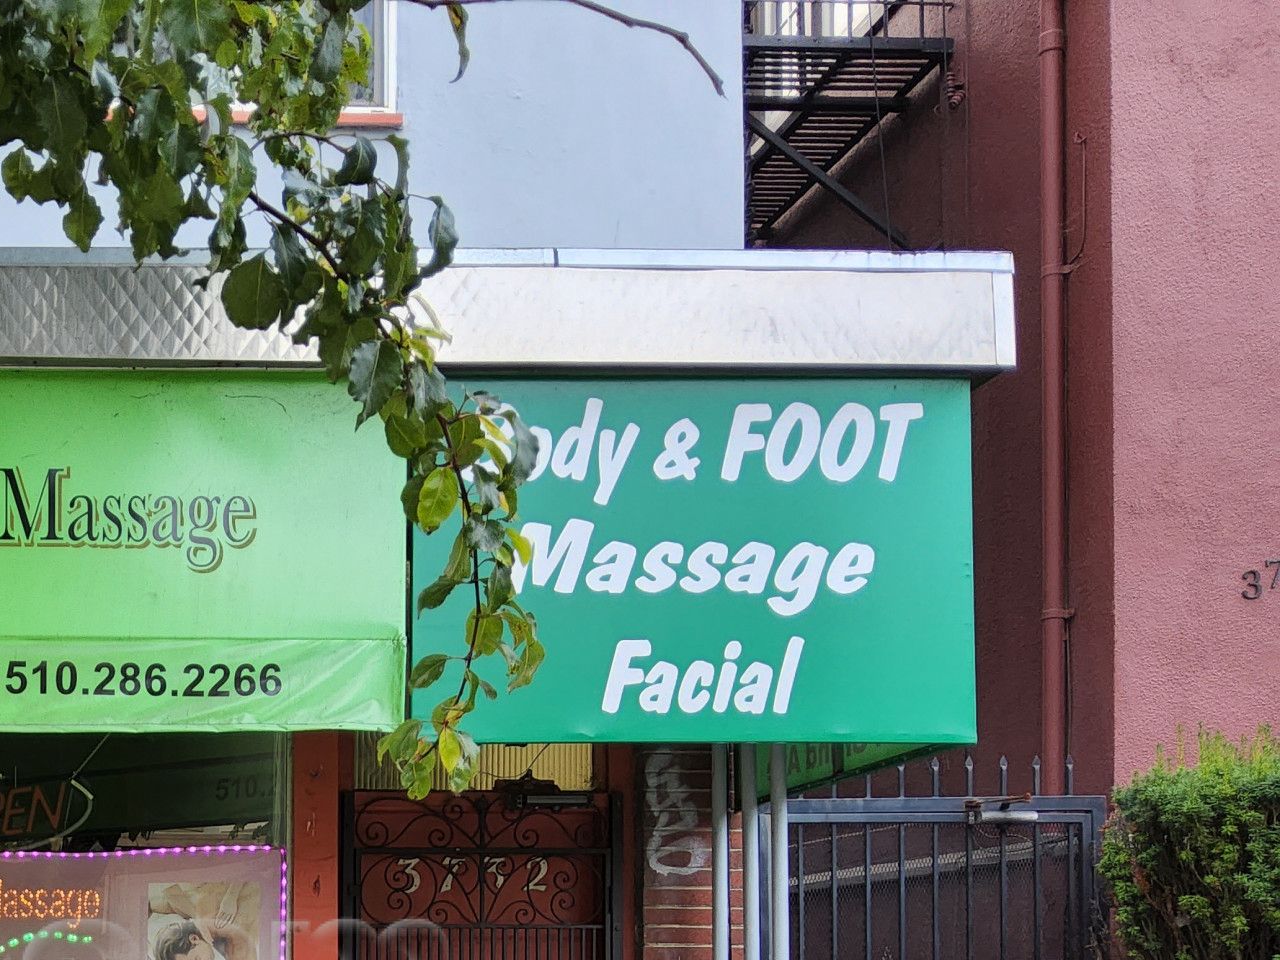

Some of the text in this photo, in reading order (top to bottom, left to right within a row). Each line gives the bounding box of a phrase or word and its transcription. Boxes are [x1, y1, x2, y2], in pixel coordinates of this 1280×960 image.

[652, 417, 701, 481] &
[720, 402, 924, 482] FOOT
[513, 518, 876, 616] Massage
[5, 660, 283, 698] 510.286.2266
[601, 636, 805, 715] Facial
